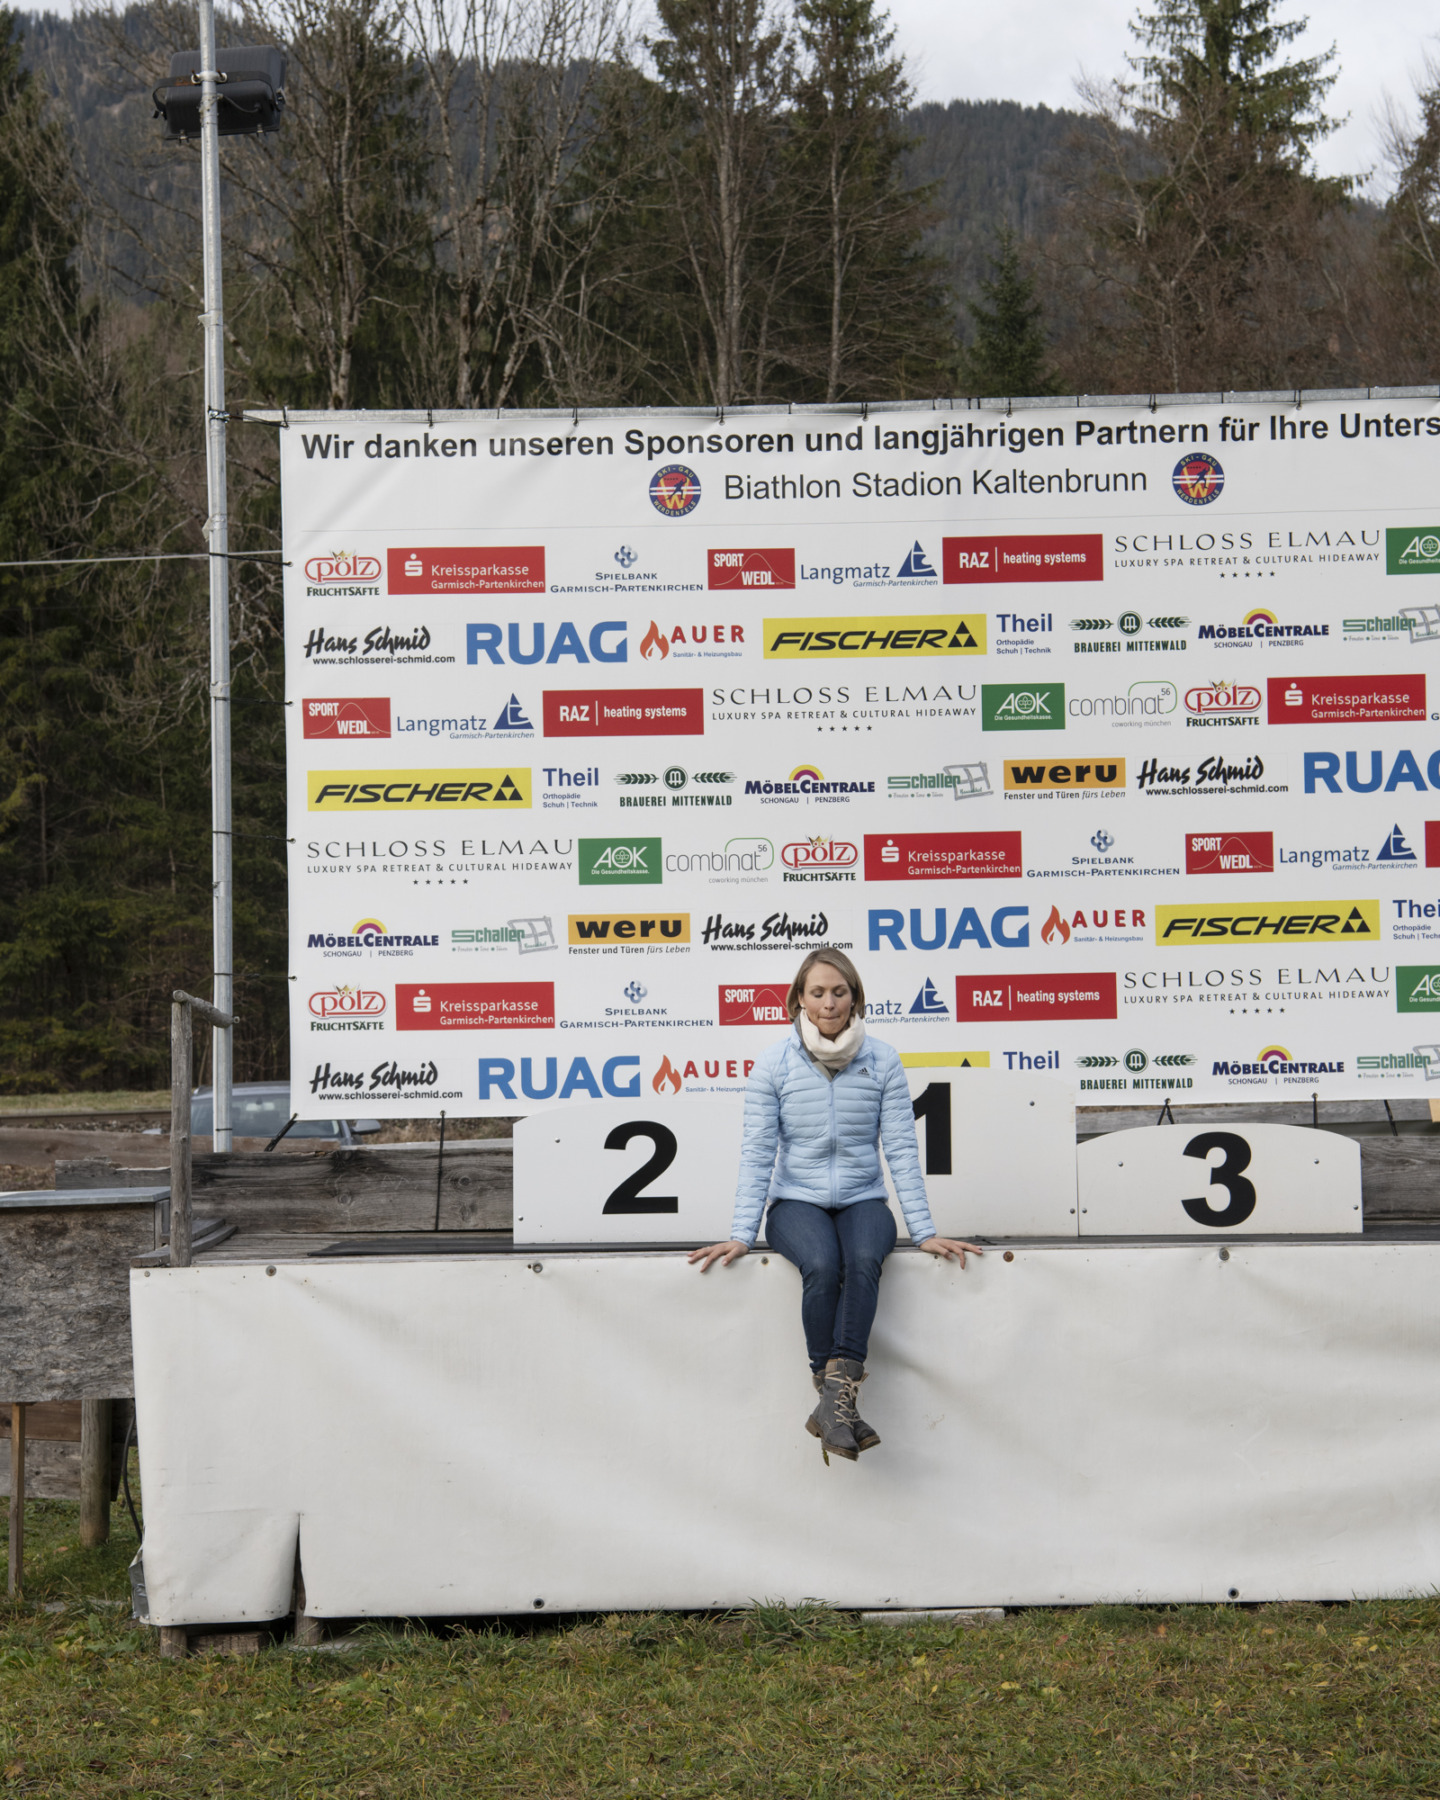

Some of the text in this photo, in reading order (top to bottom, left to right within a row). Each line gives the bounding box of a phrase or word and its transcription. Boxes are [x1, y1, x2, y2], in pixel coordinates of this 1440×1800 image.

[301, 413, 1440, 460] Wir danken unseren Sponsoren und langjährigen Partnern für Ihre Unters
[725, 468, 1146, 499] Biathlon Stadion Kaltenbrunn
[1115, 530, 1379, 552] SCHLOSS ELMAU
[315, 554, 375, 583] pölz
[714, 553, 744, 567] SPORT
[960, 552, 1086, 568] RAZ heating systems
[1115, 559, 1158, 567] LUXURY
[1190, 557, 1237, 565] RETREAT
[1243, 556, 1250, 564] &
[1256, 555, 1312, 564] CULTURAL
[1319, 554, 1379, 562] HIDEAWAY
[432, 564, 529, 578] Kreissparkasse
[596, 572, 657, 580] SPIELBANK
[741, 571, 775, 585] WEDL
[800, 563, 890, 585] Langmatz
[431, 579, 544, 589] Garmisch-Partenkirchen
[996, 613, 1052, 632] Theil
[304, 626, 430, 658] Hans Schmid
[466, 621, 627, 665] RUAG
[671, 625, 744, 643] AUER
[771, 629, 948, 651] FISCHER
[1074, 640, 1186, 653] BRAUEREI MITTENWALD
[313, 653, 455, 664] www.schlosserei-schmid.com
[713, 685, 976, 705] SCHLOSS ELMAU
[997, 692, 1050, 714] AOK
[1194, 685, 1253, 710] pölz
[1312, 692, 1409, 707] Kreissparkasse
[309, 703, 339, 716] SPORT
[560, 705, 687, 721] RAZ heating systems
[1311, 707, 1425, 719] Garmisch-Partenkirchen
[337, 720, 371, 734] WEDL
[396, 715, 487, 737] Langmatz
[543, 768, 598, 786] Theil
[1011, 765, 1116, 783] weru
[1136, 755, 1264, 789] Hans Schmid
[315, 783, 493, 803] FISCHER
[1146, 785, 1288, 795] www.schlosserei-schmid.com
[620, 795, 732, 807] BRAUEREI MITTENWALD
[308, 839, 572, 858] SCHLOSS ELMAU
[792, 840, 850, 865] pölz
[1192, 837, 1222, 851] SPORT
[593, 847, 648, 868] AOK
[909, 849, 1005, 864] Kreissparkasse
[1219, 855, 1253, 869] WEDL
[1279, 846, 1370, 868] Langmatz
[308, 865, 351, 873] LUXURY
[383, 864, 430, 872] RETREAT
[449, 863, 506, 871] CULTURAL
[908, 864, 1020, 875] Garmisch-Partenkirchen
[1333, 862, 1417, 870] Garmisch-Partenkirchen
[701, 912, 828, 944] Hans Schmid
[1072, 910, 1145, 928] AUER
[1163, 915, 1340, 938] FISCHER
[576, 920, 681, 938] weru
[868, 906, 1029, 951] RUAG
[602, 946, 618, 954] und
[647, 946, 663, 955] fürs
[666, 945, 690, 953] Leben
[710, 941, 853, 951] www.schlosserei-schmidcom
[1124, 967, 1389, 988] SCHLOSS ELMAU
[320, 991, 378, 1015] pölz
[725, 989, 756, 1003] SPORT
[973, 990, 1100, 1006] RAZ heating systems
[441, 1000, 538, 1014] Kreissparkasse
[753, 1007, 786, 1021] WEDL
[440, 1015, 553, 1025] Garmisch-Partenkirchen
[1003, 1051, 1059, 1070] Theil
[309, 1061, 438, 1094] Hans Schmid
[479, 1056, 641, 1100] RUAG
[1081, 1078, 1192, 1090] BRAUEREI MITTENWALD
[319, 1088, 462, 1100] www.schlosserei-schmid.com
[913, 1082, 952, 1176] 1
[602, 1121, 678, 1214] 2
[1181, 1132, 1256, 1227] 3
